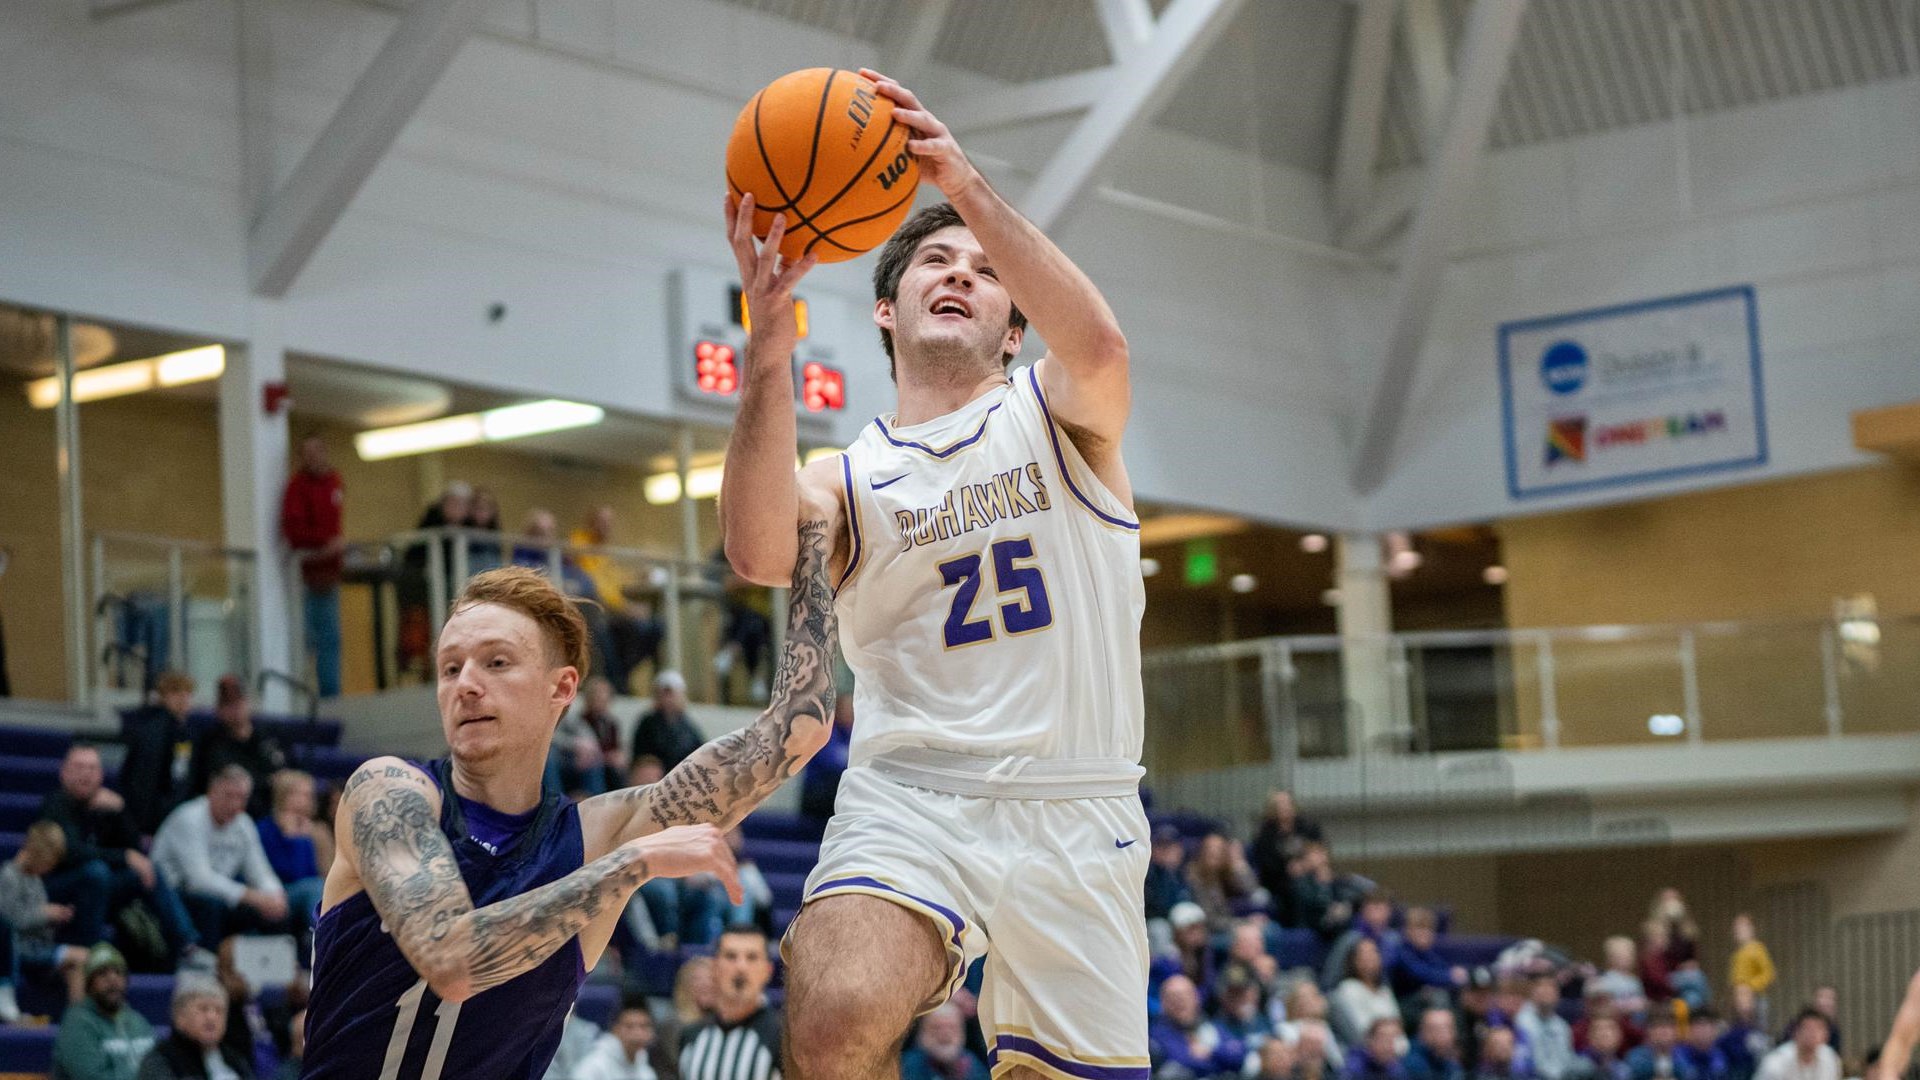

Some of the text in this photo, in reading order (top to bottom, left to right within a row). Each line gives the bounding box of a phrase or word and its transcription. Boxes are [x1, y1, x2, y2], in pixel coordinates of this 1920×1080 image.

[847, 80, 877, 130] VO
[895, 462, 1052, 553] DUHAWKS
[934, 533, 1055, 652] 25
[378, 977, 462, 1080] 11
